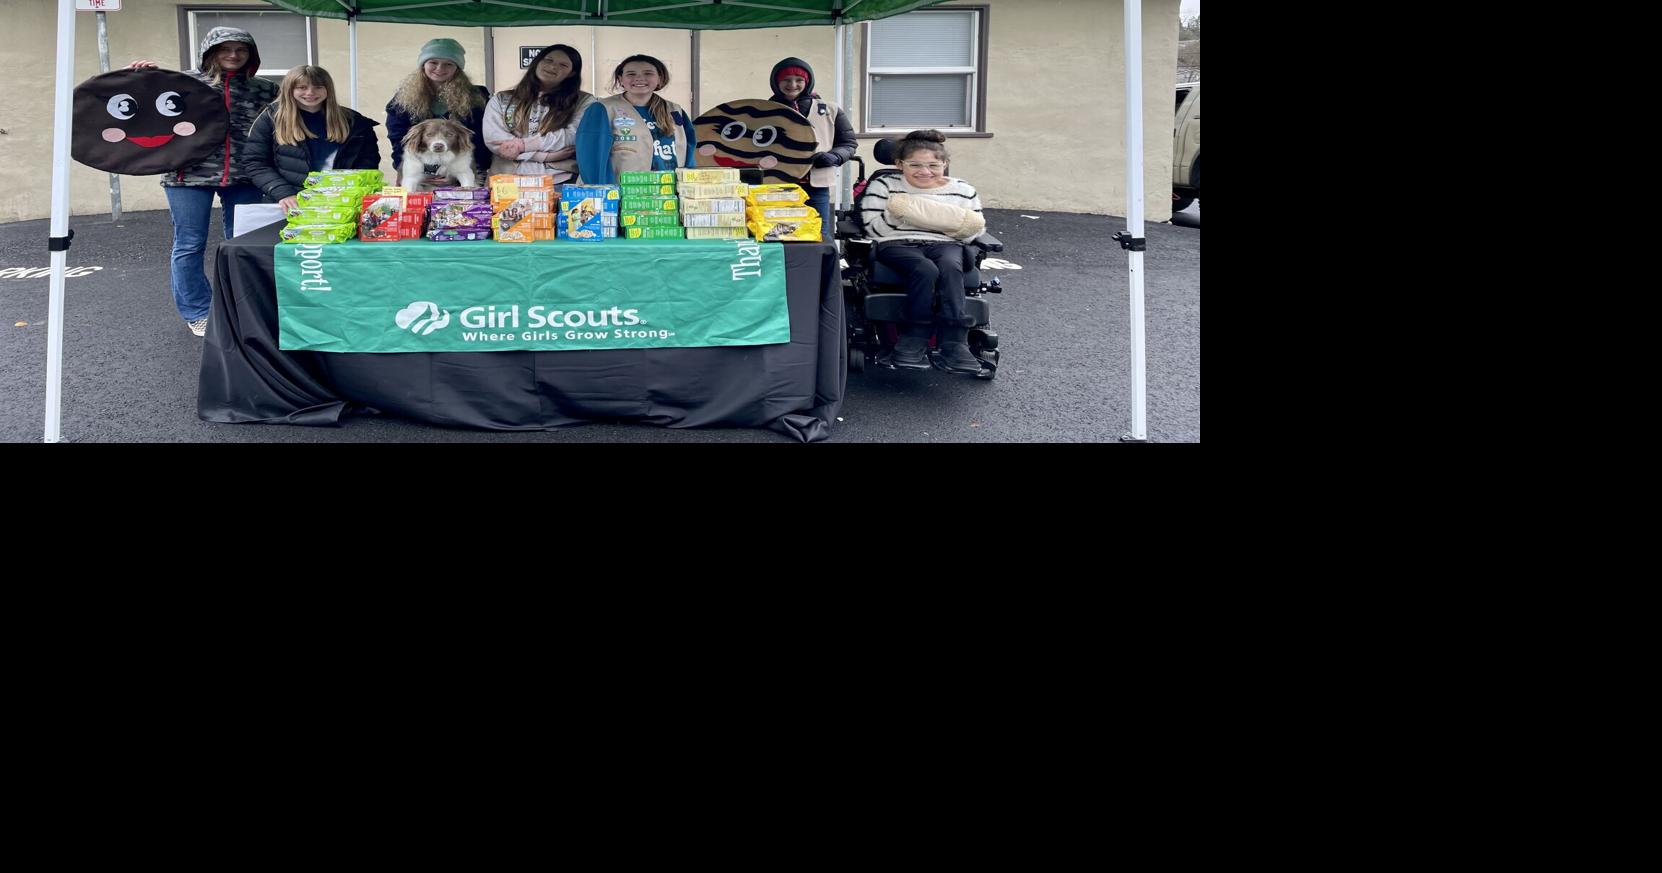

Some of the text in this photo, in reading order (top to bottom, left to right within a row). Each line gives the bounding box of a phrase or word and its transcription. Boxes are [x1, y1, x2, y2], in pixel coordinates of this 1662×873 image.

[460, 305, 641, 329] Girl Scouts
[462, 329, 668, 342] Where Girls Grow Strong
